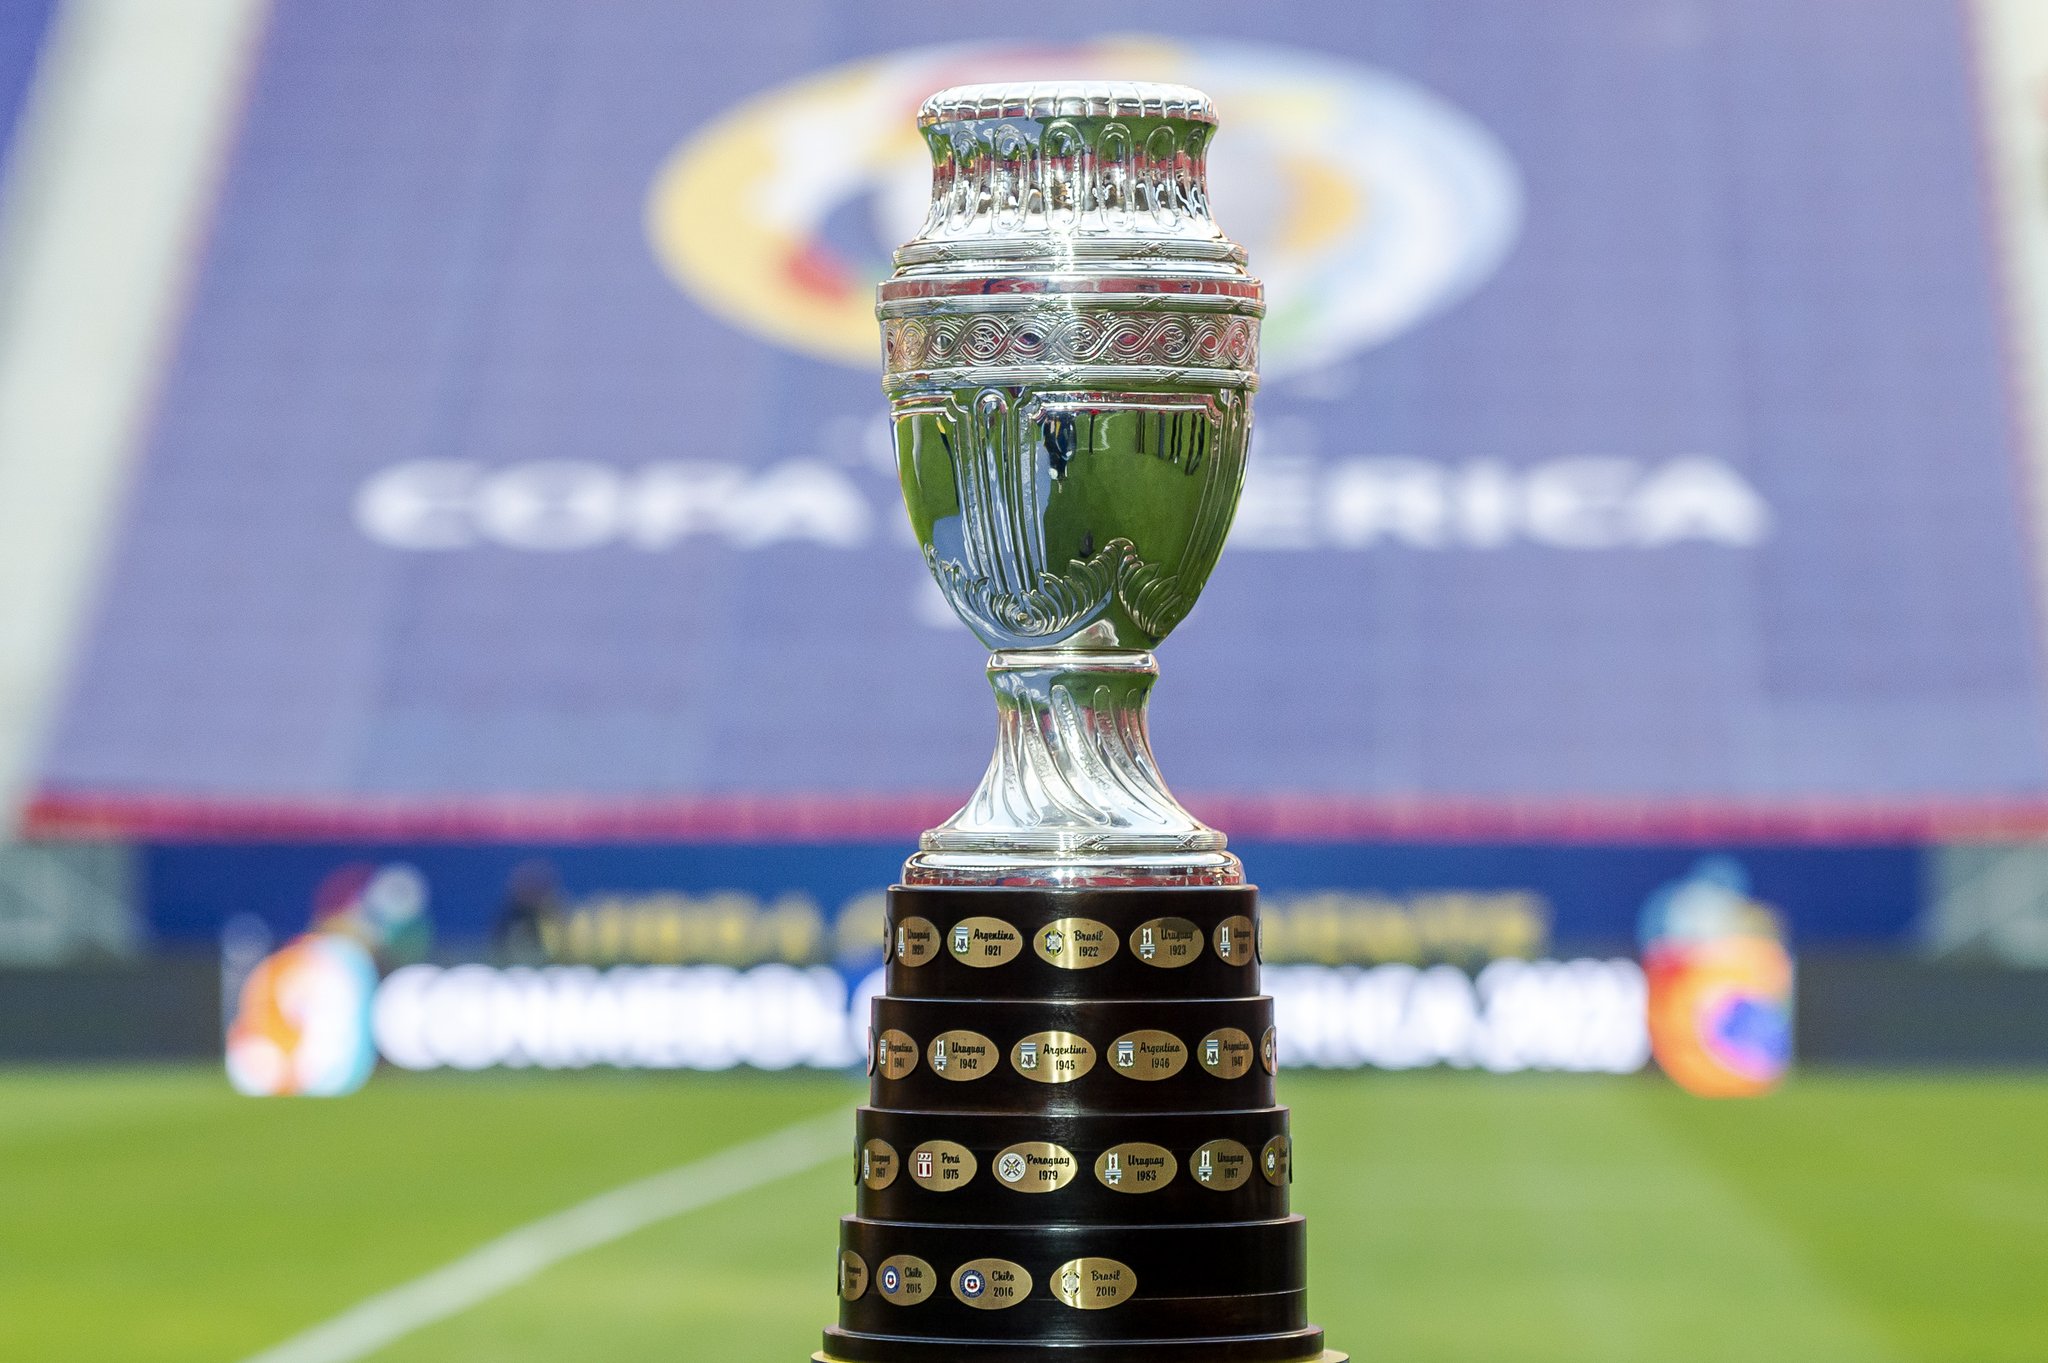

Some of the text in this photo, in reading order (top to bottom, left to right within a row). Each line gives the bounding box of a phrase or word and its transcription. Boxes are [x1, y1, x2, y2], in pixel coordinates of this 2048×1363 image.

[357, 456, 1774, 552] COPA ERICA
[973, 928, 1015, 942] Argentina
[1073, 929, 1104, 942] Brasil
[1161, 928, 1194, 943] Uruguay
[985, 945, 1001, 956] 1921
[1079, 946, 1099, 957] 1922
[1169, 944, 1187, 956] 1923
[952, 1042, 986, 1055] Uruguay
[1043, 1043, 1088, 1057] Argentina
[1139, 1042, 1181, 1055] Argentina
[1222, 1040, 1250, 1053] Argentina
[959, 1058, 977, 1070] 1942
[1055, 1060, 1076, 1071] 1945
[1151, 1058, 1170, 1069] 1946
[1231, 1056, 1244, 1067] 1947
[941, 1152, 961, 1164] Perú
[1026, 1154, 1070, 1167] Paraguay
[1127, 1154, 1165, 1168] Uruguay
[1217, 1152, 1244, 1165] Uruguay
[943, 1169, 960, 1180] 1975
[1038, 1170, 1058, 1181] 1979
[1136, 1170, 1157, 1182] 1983
[904, 1266, 923, 1278] Chile
[991, 1270, 1016, 1282] Chile
[1091, 1269, 1121, 1281] Brasil
[906, 1283, 922, 1294] 2015
[993, 1287, 1014, 1298] 2016
[1095, 1286, 1117, 1297] 2019
